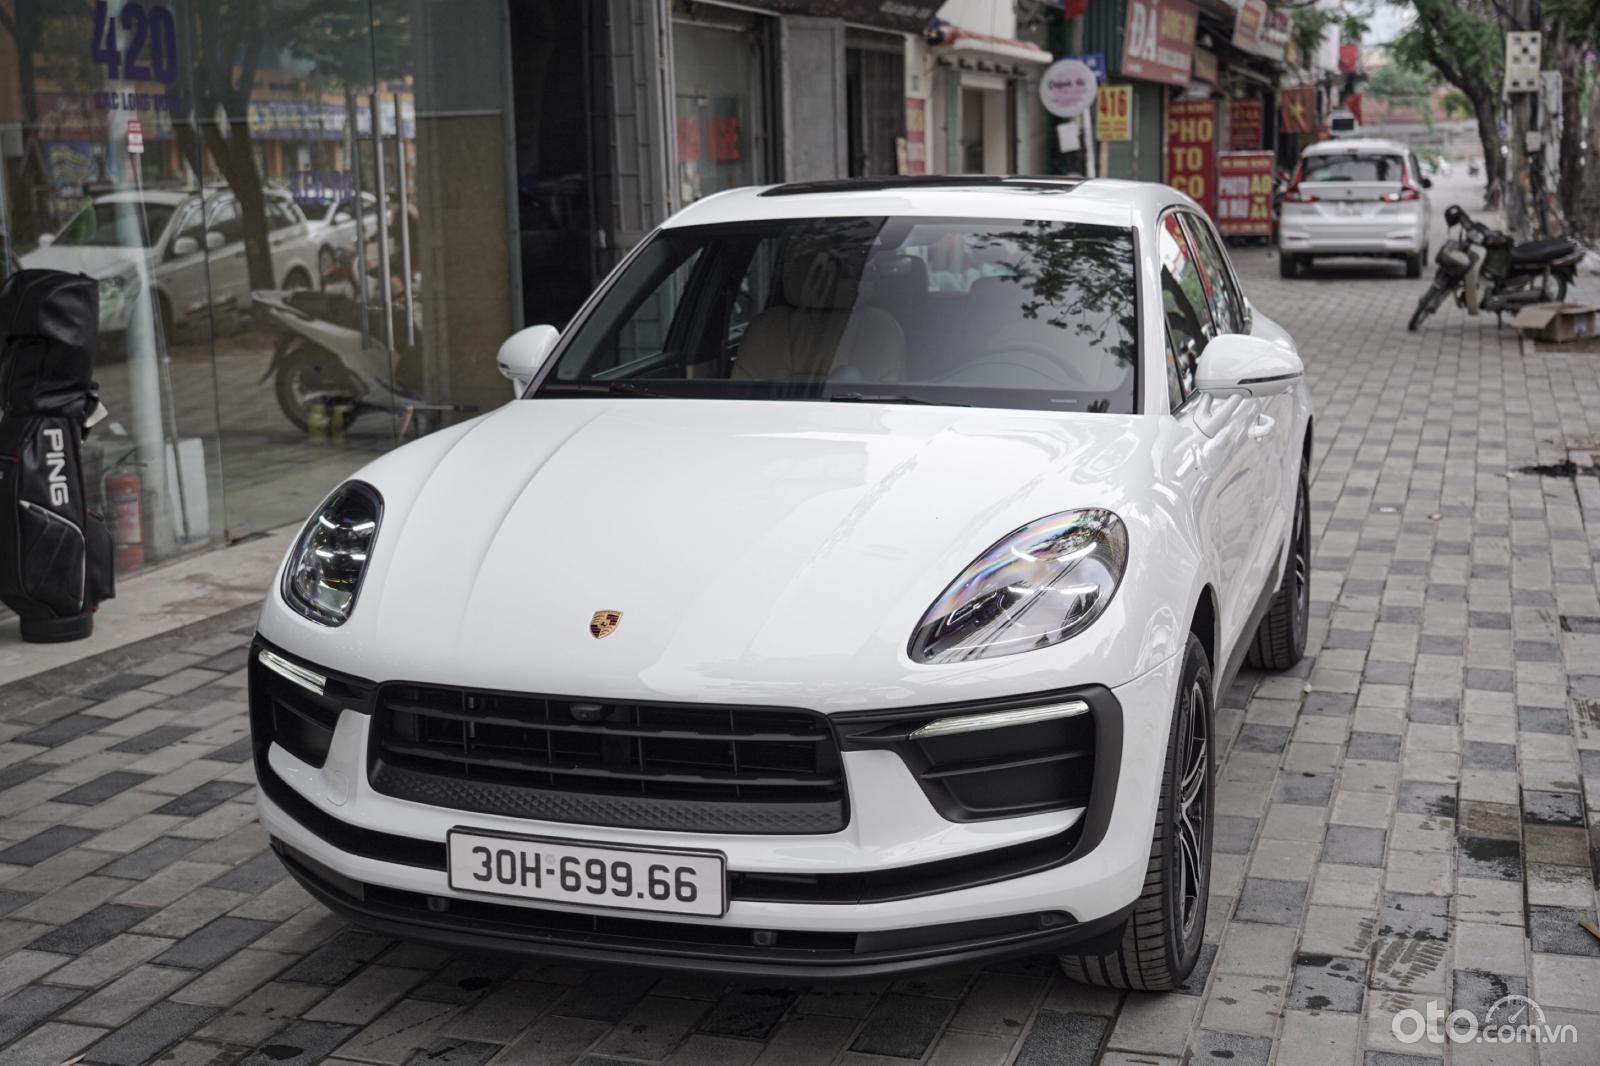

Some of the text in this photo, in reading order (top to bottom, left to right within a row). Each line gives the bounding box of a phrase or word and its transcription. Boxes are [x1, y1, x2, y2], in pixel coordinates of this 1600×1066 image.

[92, 0, 178, 84] 420
[1168, 118, 1213, 142] PHO
[1172, 147, 1204, 172] TO
[43, 428, 69, 507] PING
[472, 846, 698, 903] 30H-699.66
